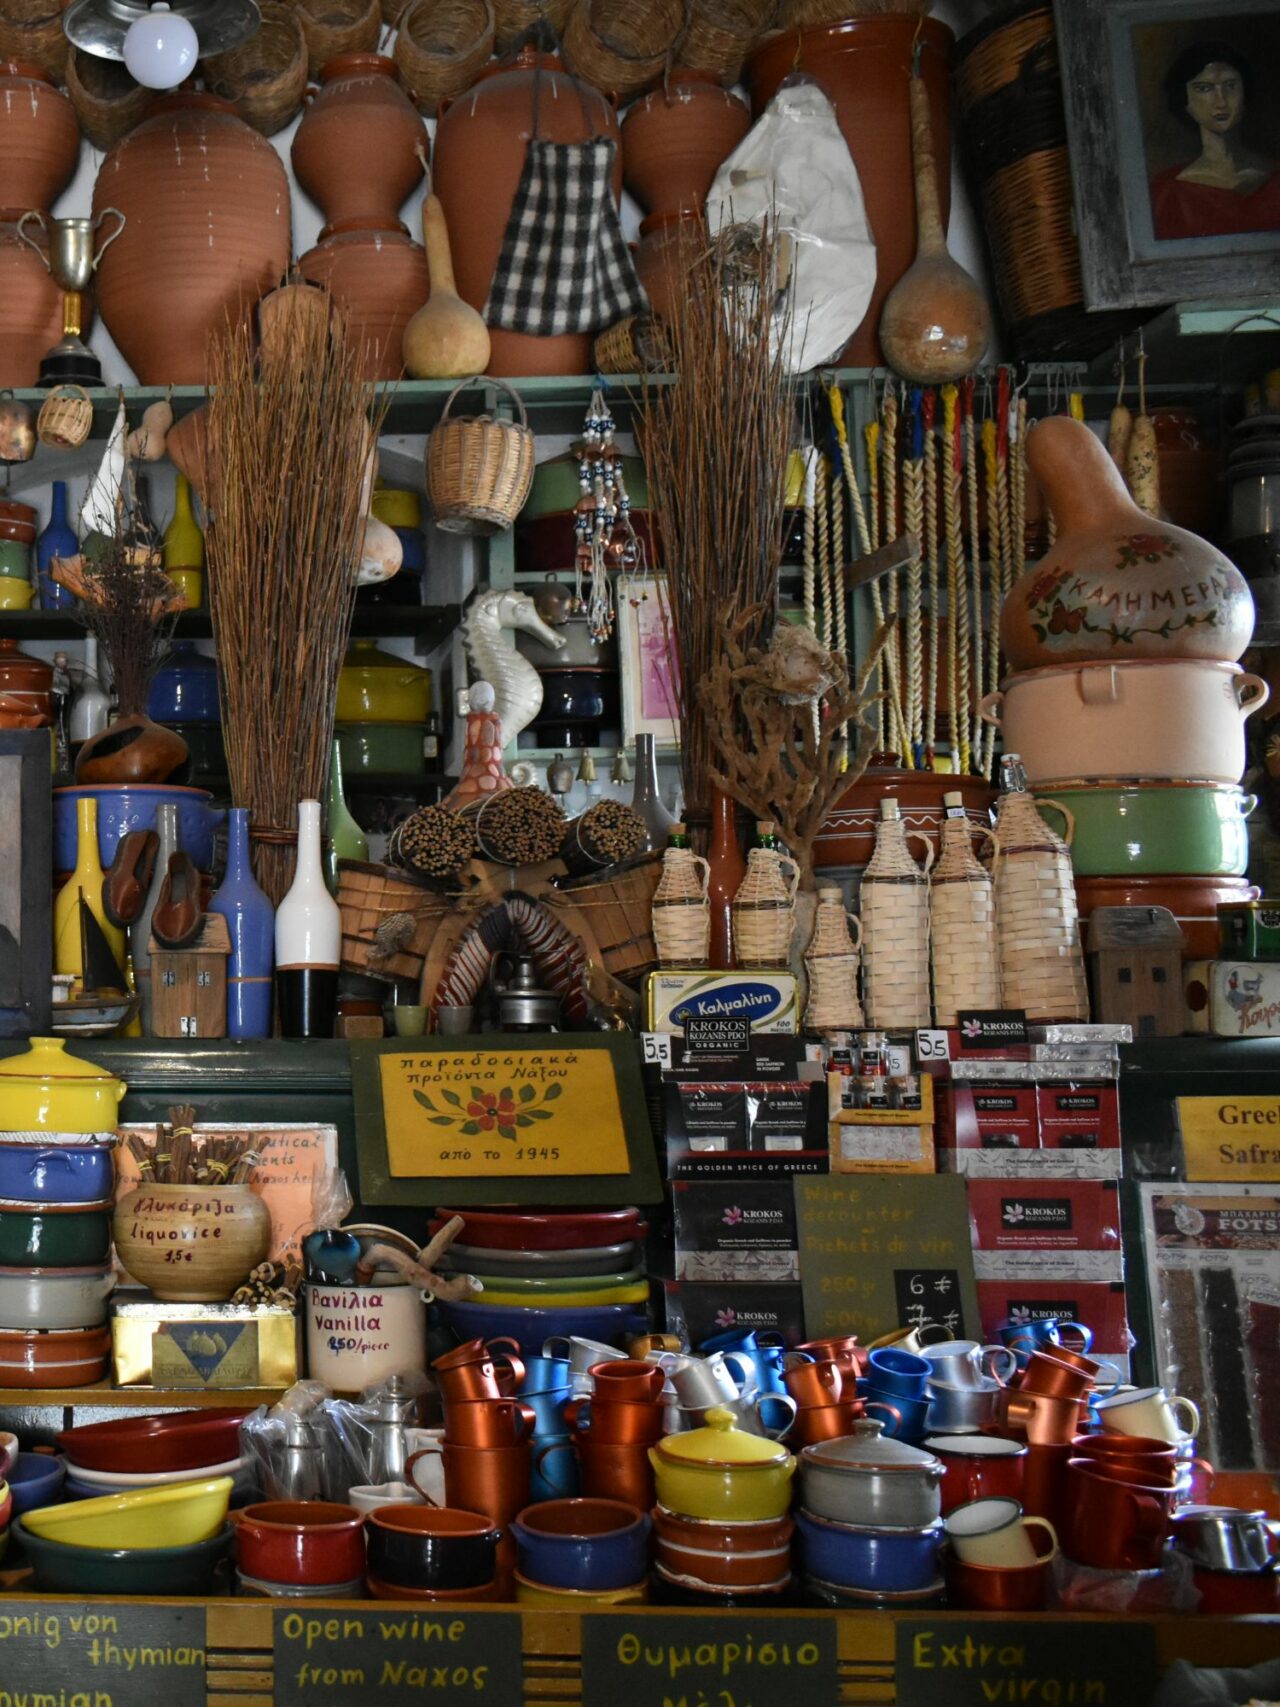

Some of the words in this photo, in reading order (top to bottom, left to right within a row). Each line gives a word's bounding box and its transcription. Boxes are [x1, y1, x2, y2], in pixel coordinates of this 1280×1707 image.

[1068, 575, 1222, 611] ΚΑΛΗΜΕΡΑ
[698, 992, 772, 1017] Καλμαλίνη
[689, 1032, 726, 1040] KOZANIS
[727, 1032, 746, 1040] PDO
[690, 1021, 746, 1031] KROKOS
[983, 1022, 1024, 1030] KROKOS
[645, 1037, 668, 1060] 5,5
[400, 1052, 579, 1070] παραδοσιακά
[407, 1069, 495, 1087] προϊόντα
[510, 1067, 568, 1082] Νάξου
[439, 1147, 472, 1160] από
[483, 1151, 501, 1160] το
[515, 1148, 560, 1160] 1945
[743, 1210, 783, 1218] KROKOS
[1025, 1208, 1066, 1216] KROKOS
[1220, 1210, 1280, 1218] ΜΠΑΧΑΡΙΚ
[130, 1222, 222, 1245] liquorice
[1218, 1218, 1280, 1231] FOTS
[910, 1275, 925, 1295] 6
[312, 1288, 383, 1309] Βανίλια
[315, 1315, 381, 1331] Vanilla
[737, 1312, 777, 1320] KROKOS
[1031, 1310, 1072, 1318] KROKOS
[69, 1614, 117, 1634] von
[283, 1613, 364, 1650] Open
[379, 1614, 465, 1642] wine
[88, 1637, 206, 1671] thymian
[617, 1632, 819, 1678] Θυμαρίσιο
[913, 1631, 1024, 1668] Extra
[295, 1662, 364, 1688] from
[379, 1660, 488, 1690] Naxos
[980, 1672, 1106, 1707] virgin
